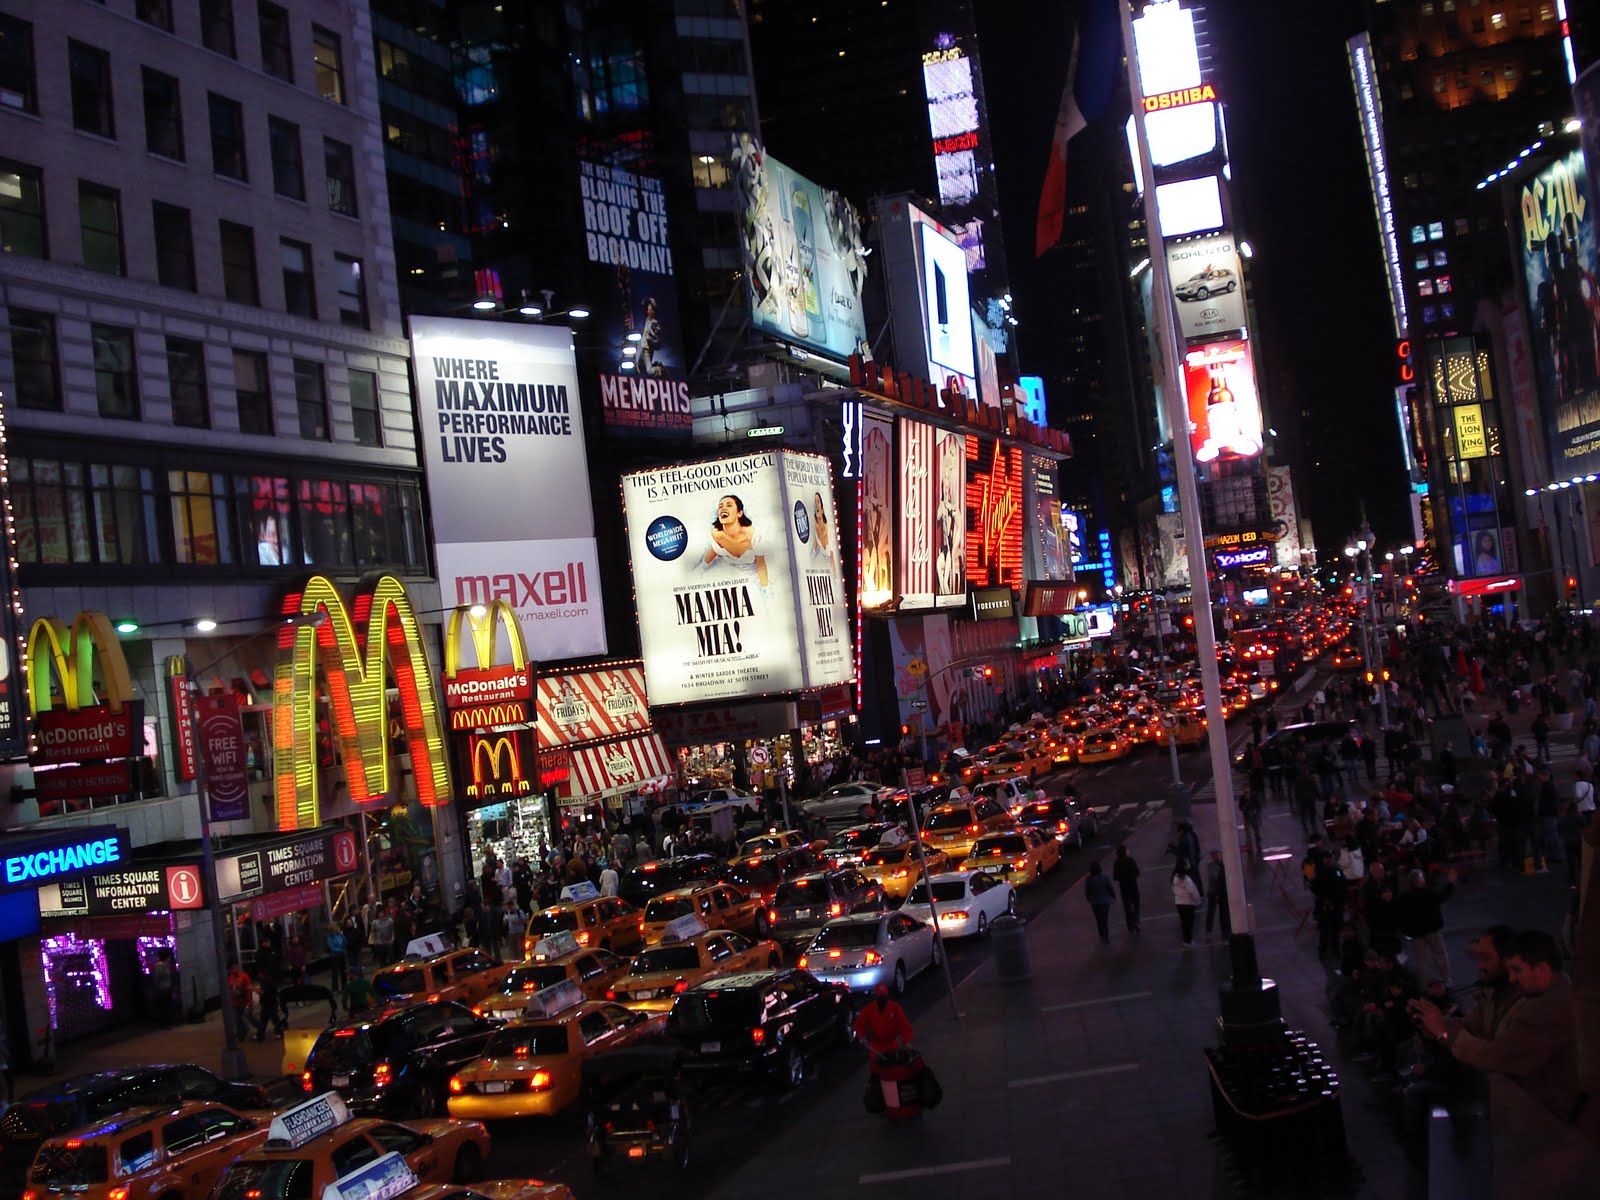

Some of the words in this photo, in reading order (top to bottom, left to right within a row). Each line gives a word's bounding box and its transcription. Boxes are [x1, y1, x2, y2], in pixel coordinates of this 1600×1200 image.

[1353, 46, 1380, 149] reuters.com/mobile
[580, 176, 639, 209] BLOWING
[641, 190, 666, 215] THE
[1380, 196, 1392, 212] for
[583, 199, 630, 238] ROOF
[637, 211, 667, 245] OFF
[586, 232, 673, 276] BROADWAY!
[433, 356, 499, 380] WHERE
[434, 379, 569, 414] MAXIMUM
[600, 373, 691, 414] MEMPHIS
[438, 412, 571, 436] PERFORMANCE
[1461, 414, 1476, 422] THE
[1460, 424, 1481, 438] LION
[440, 436, 507, 463] LIVES
[1461, 438, 1483, 452] KING
[625, 471, 657, 488] “THIS
[660, 464, 721, 484] FEEL-GOOD
[724, 454, 775, 474] MUSICAL
[787, 471, 807, 484] POPULAR
[647, 487, 658, 499] IS
[661, 484, 669, 497] A
[647, 525, 684, 542] WORLDWIDE
[1242, 532, 1257, 541] CEO
[1216, 549, 1267, 567] YAHOO!
[455, 562, 587, 608] maxell
[806, 575, 835, 606] MAMMA
[674, 585, 755, 626] MAMMA
[977, 601, 1002, 611] FOREVER
[1002, 599, 1010, 608] 21
[695, 620, 743, 658] MIA!
[737, 667, 759, 675] THEATRE
[447, 674, 528, 696] McDonald's
[695, 680, 725, 688] BROADWAY
[179, 681, 188, 716] OPEN
[461, 690, 515, 704] Restaurant
[607, 696, 633, 711] FRIDAY'S
[556, 704, 585, 719] FRIDAY'S
[181, 719, 191, 727] 24
[45, 743, 111, 758] Restaurant
[208, 736, 237, 750] FREE
[184, 730, 195, 774] HOURS
[212, 751, 237, 765] WIFI
[610, 761, 630, 772] FRIDAY'S
[267, 847, 293, 863] TIMES
[294, 839, 324, 857] SQUARE
[6, 838, 120, 883] EXCHANGE
[241, 860, 257, 870] TIMES
[271, 852, 324, 877] INFORMATION
[92, 873, 121, 886] TIMES
[123, 871, 160, 883] SQUARE
[241, 868, 259, 879] SQUARE
[284, 869, 314, 887] CENTER
[62, 889, 83, 897] SQUARE
[96, 884, 159, 898] INFORMATION
[111, 897, 147, 910] CENTER
[285, 1099, 331, 1130] FLASHDANCERS
[290, 1114, 321, 1138] GENTLEMEN'S
[321, 1110, 334, 1122] CLUB
